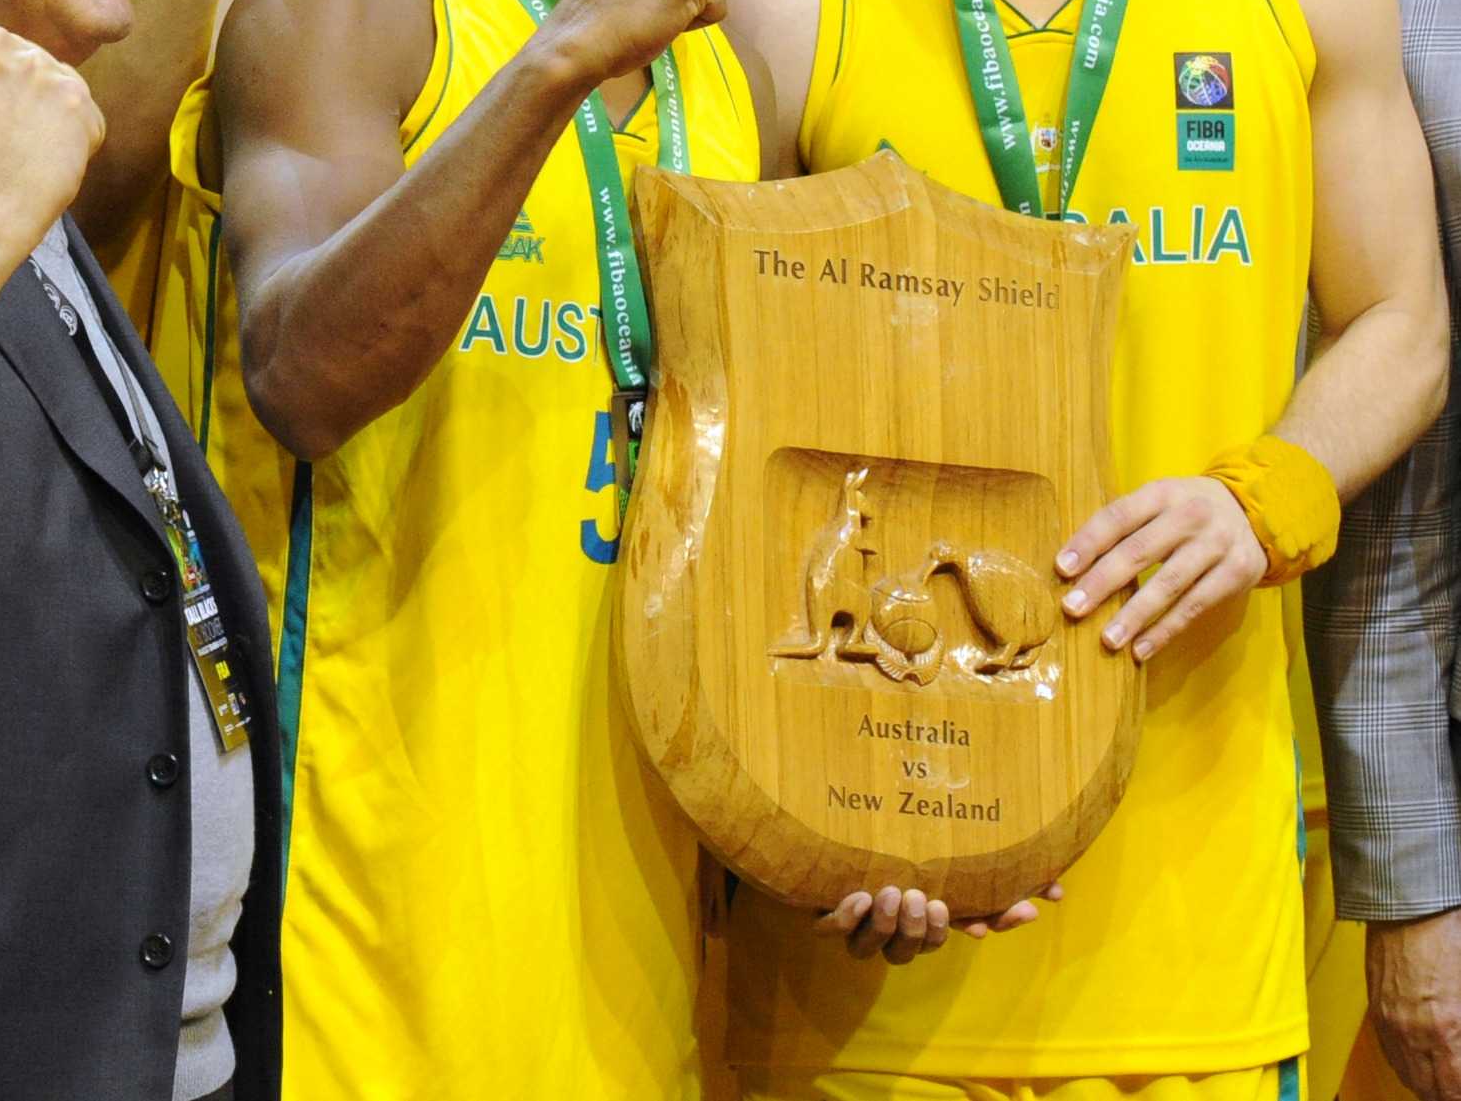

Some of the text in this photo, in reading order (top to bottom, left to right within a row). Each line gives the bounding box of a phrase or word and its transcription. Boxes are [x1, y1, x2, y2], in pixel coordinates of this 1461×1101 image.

[1186, 120, 1226, 140] FIBA
[753, 250, 1060, 311] The Al Ramsay Shield
[857, 714, 971, 747] Australia
[902, 759, 928, 777] vs
[828, 785, 1002, 822] New Zealand
